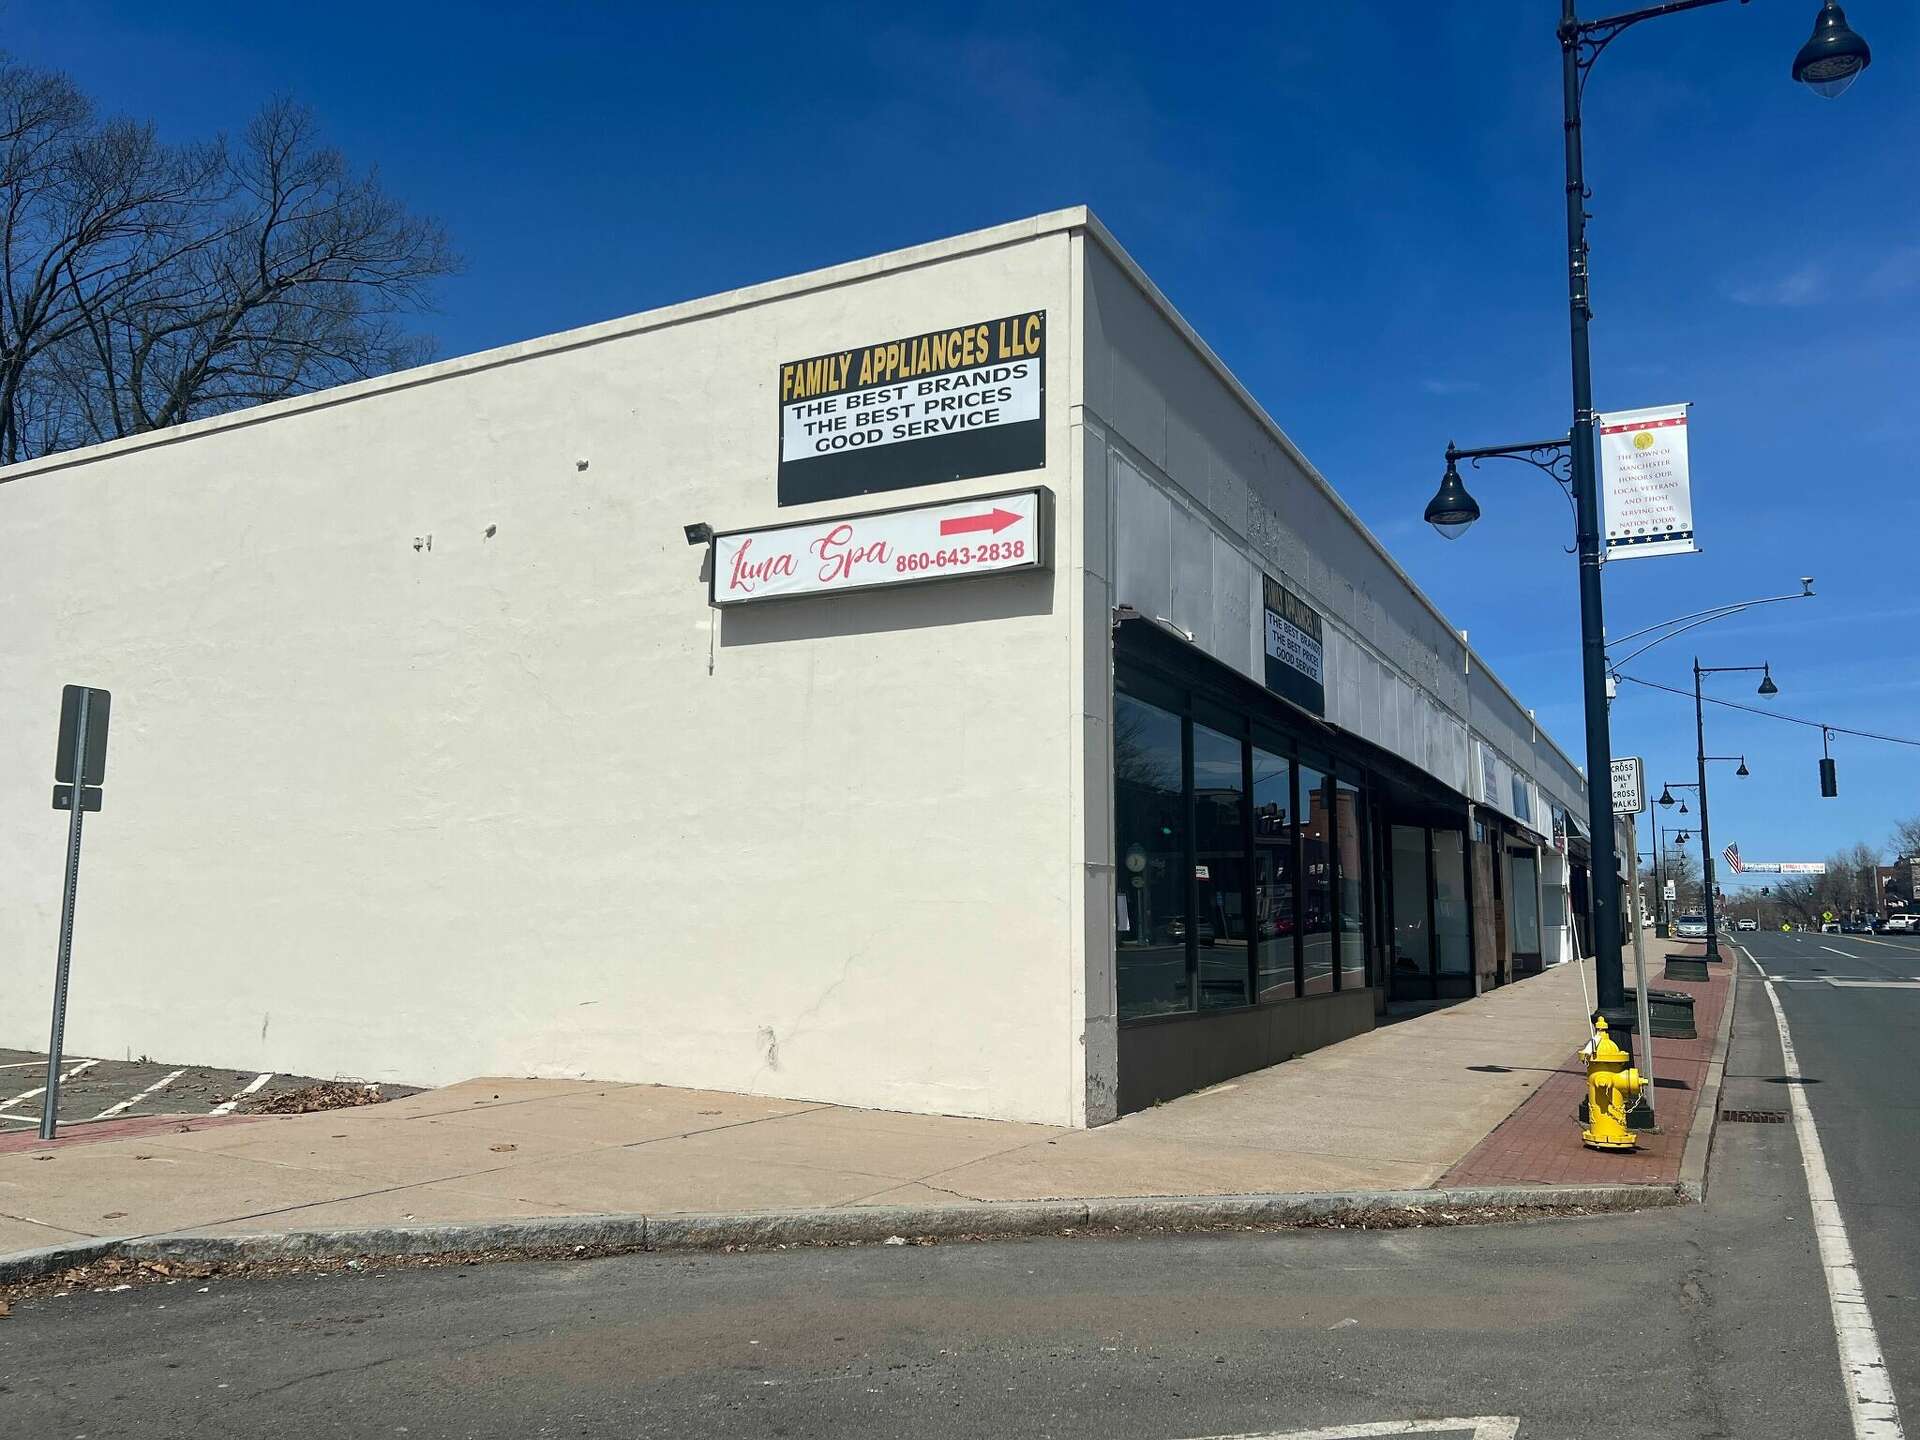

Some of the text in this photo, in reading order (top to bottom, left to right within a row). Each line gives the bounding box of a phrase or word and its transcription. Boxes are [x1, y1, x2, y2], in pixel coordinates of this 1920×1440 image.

[783, 315, 1040, 401] FAMILY APPLIANCES LLC
[792, 364, 1028, 420] THE BEST BRANDS
[804, 387, 1012, 436] THE BEST PRICES
[815, 408, 1000, 452] GOOD SERVICE
[1635, 450, 1658, 459] TOWN
[1619, 460, 1671, 471] MANCHESTER
[1618, 471, 1673, 483] HONORS OUR
[1613, 482, 1679, 495] LOCAL VETERANS
[1624, 497, 1642, 505] AND
[1621, 505, 1674, 517] SERVING OUR
[1619, 517, 1676, 528] NATION TODAY
[730, 525, 1025, 592] Luna Spa 860-643-2838
[1268, 612, 1283, 630] THE
[1283, 622, 1299, 640] BEST
[1272, 630, 1286, 647] THE
[1286, 638, 1301, 655] BEST
[1276, 646, 1295, 665] GOOD
[1611, 764, 1633, 772] CROSS
[1613, 774, 1632, 783] ONLY
[1613, 790, 1635, 798] CROSS
[1612, 800, 1637, 809] WALKS
